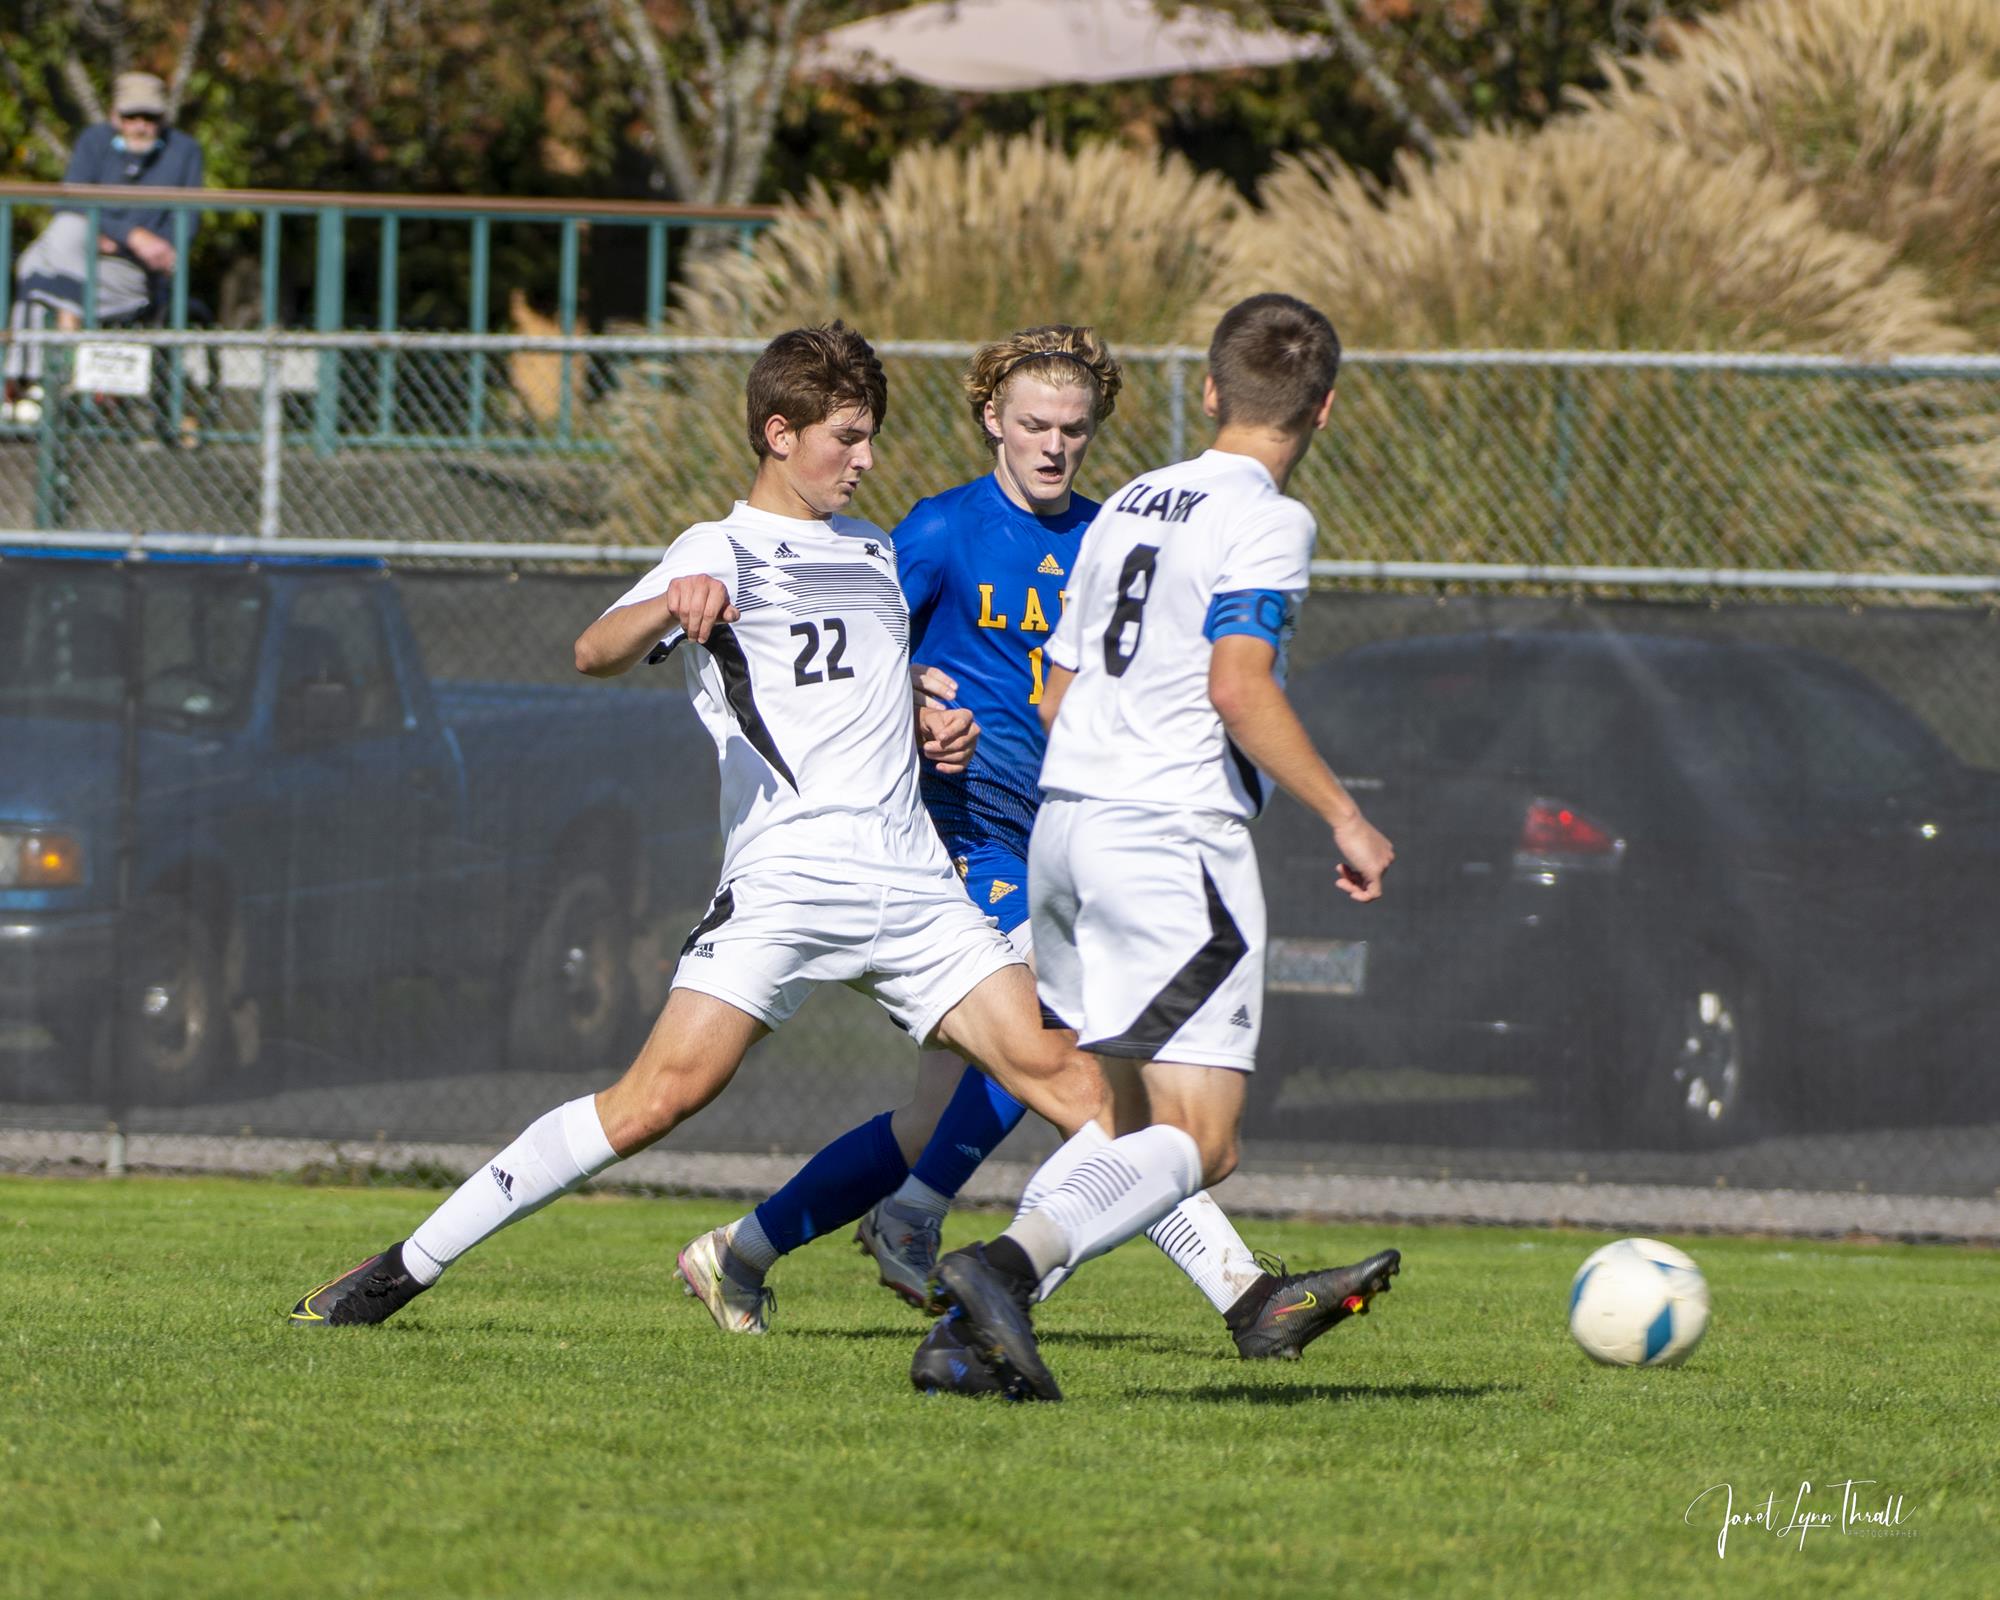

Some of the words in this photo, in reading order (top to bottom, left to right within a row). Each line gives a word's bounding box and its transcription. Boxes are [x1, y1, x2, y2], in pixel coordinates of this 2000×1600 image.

[977, 583, 1068, 633] LA
[1103, 542, 1161, 679] 8
[789, 617, 855, 688] 22
